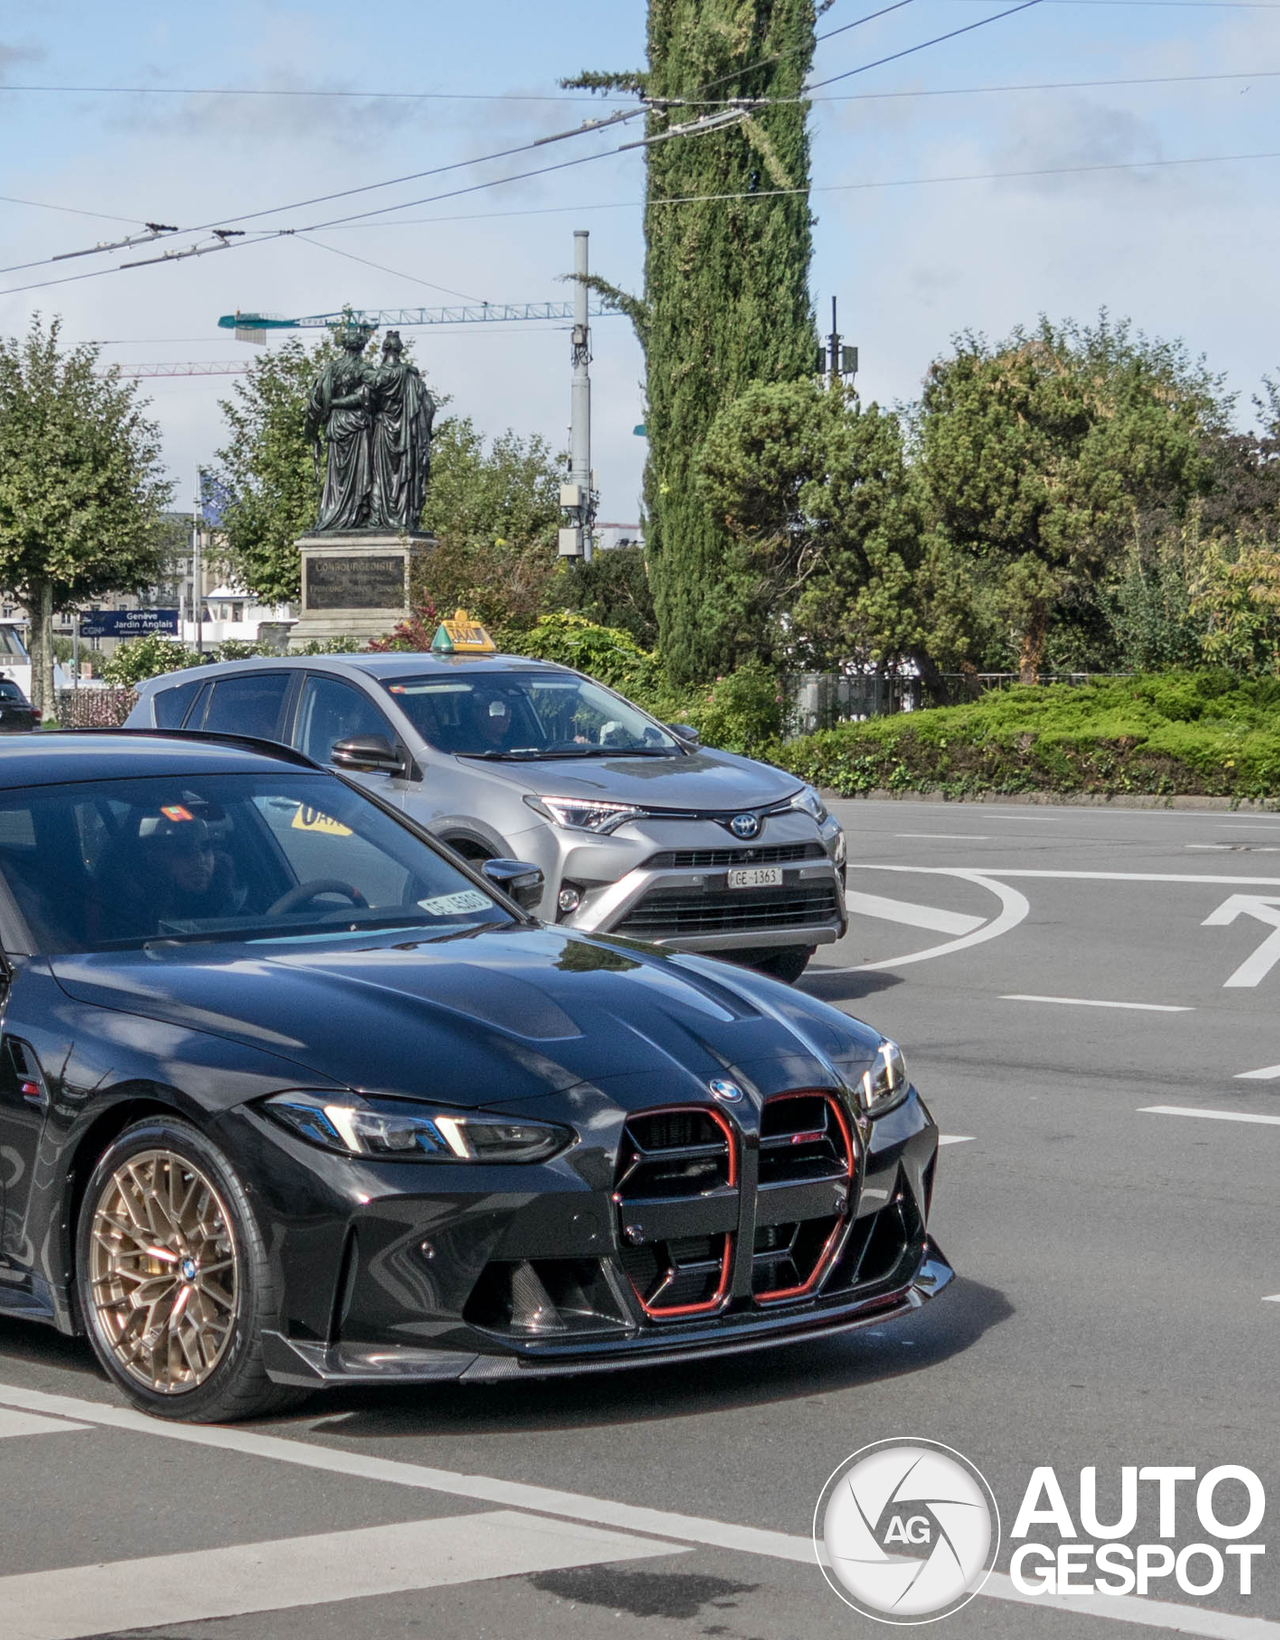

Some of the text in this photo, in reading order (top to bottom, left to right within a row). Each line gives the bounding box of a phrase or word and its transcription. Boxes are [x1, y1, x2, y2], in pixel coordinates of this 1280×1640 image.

[127, 612, 158, 620] Genève
[114, 620, 174, 630] Jardin Anglais
